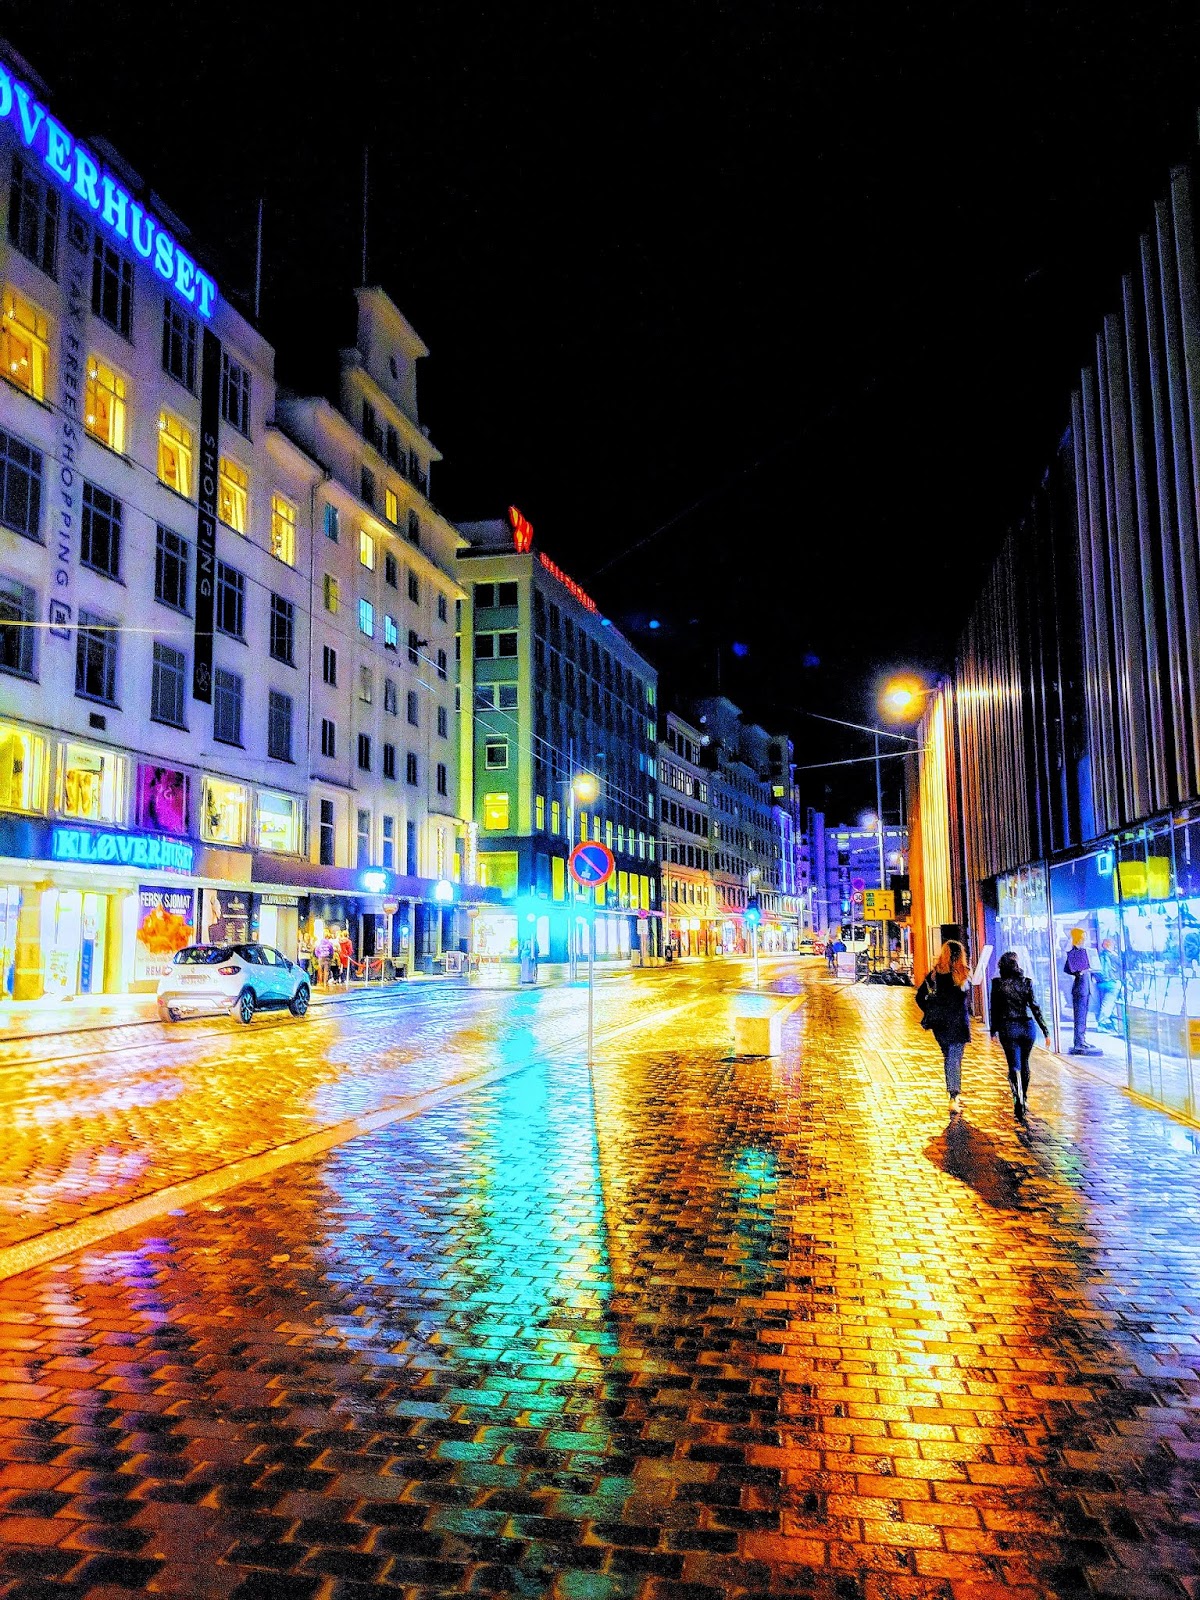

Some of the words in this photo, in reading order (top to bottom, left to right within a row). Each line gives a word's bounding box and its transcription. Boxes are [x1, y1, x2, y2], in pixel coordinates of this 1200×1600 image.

[65, 334, 79, 412] FREE
[56, 422, 77, 588] SHOPPING
[201, 432, 215, 597] SHOPPING
